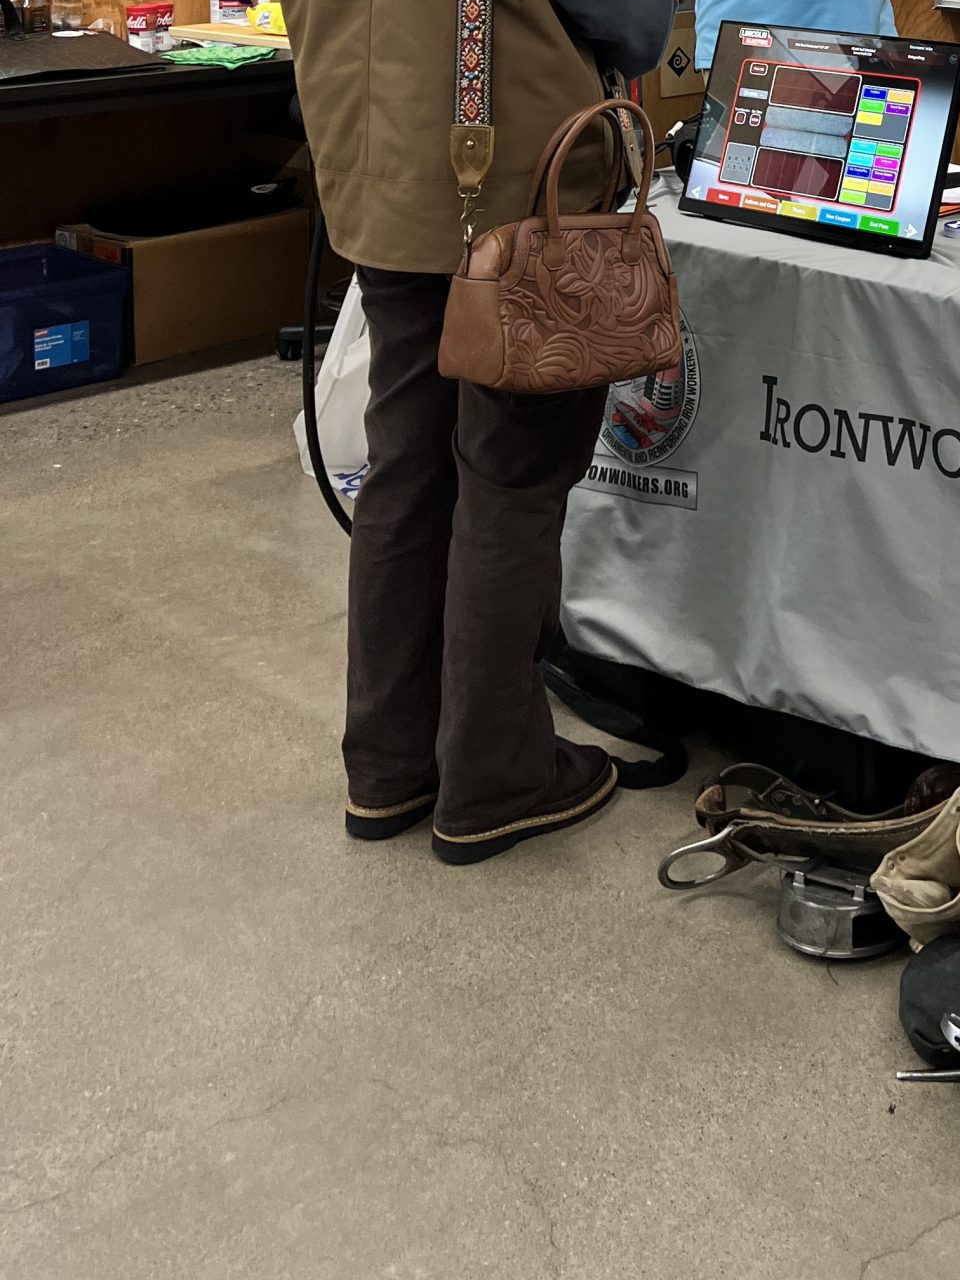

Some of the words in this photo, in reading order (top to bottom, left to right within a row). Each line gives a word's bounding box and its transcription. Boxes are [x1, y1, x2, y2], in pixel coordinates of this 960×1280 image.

[741, 29, 768, 38] LINCOLN
[685, 348, 698, 396] WORKERS
[682, 396, 696, 422] IRON
[648, 418, 688, 461] REINFORCING
[587, 465, 689, 498] ONWORKERS.ORG
